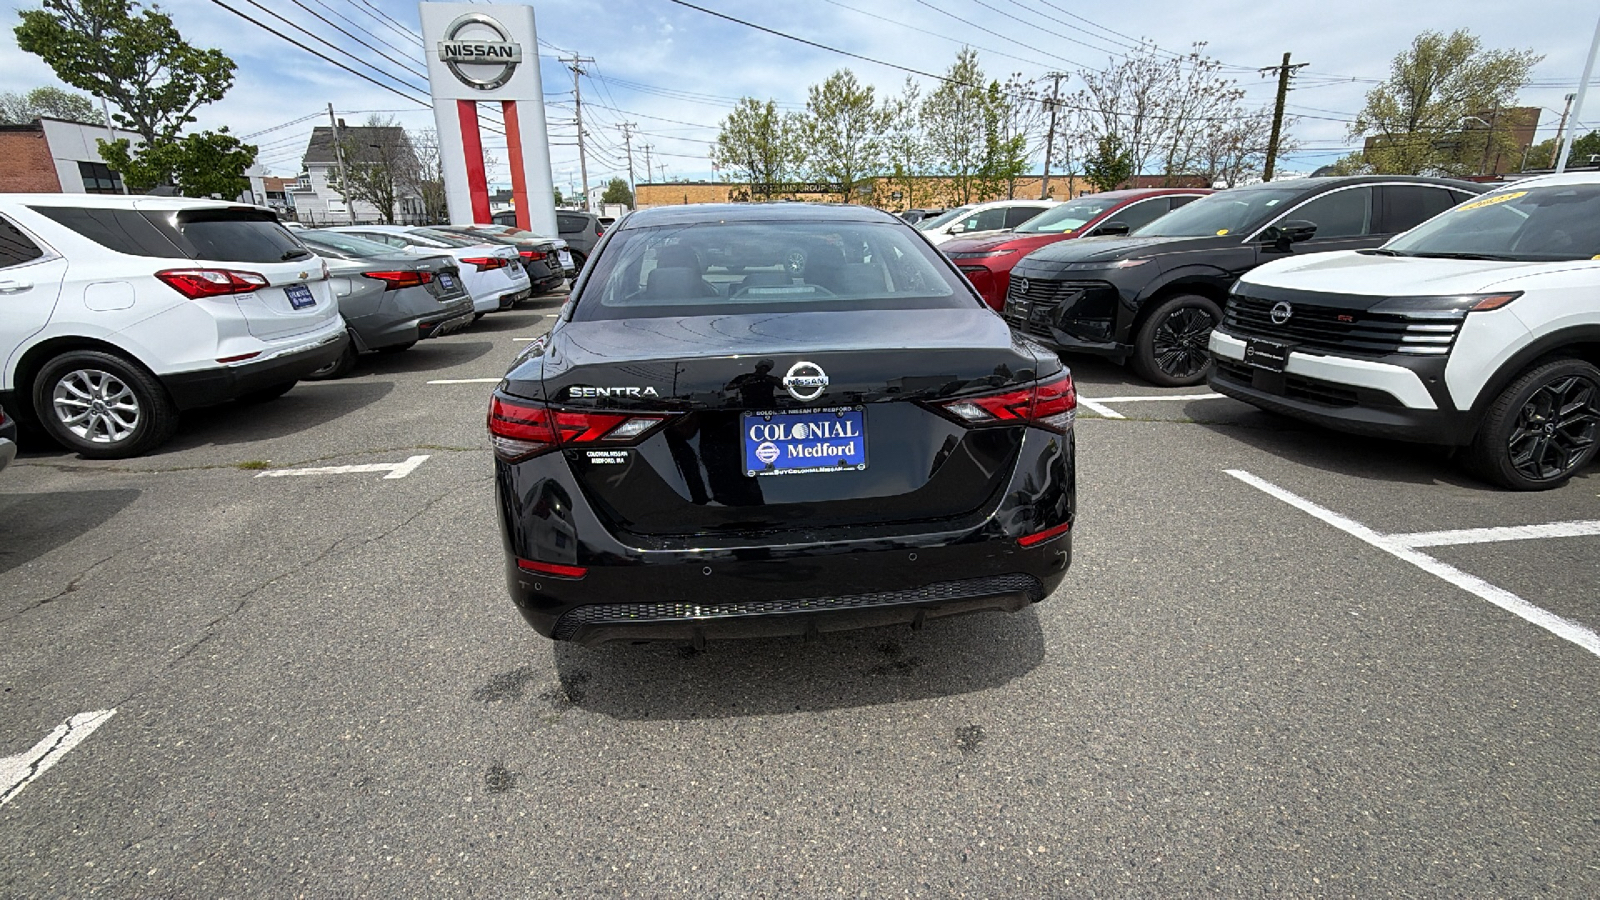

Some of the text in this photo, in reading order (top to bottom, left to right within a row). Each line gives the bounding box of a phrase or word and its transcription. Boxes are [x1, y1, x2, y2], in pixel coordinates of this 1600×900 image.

[444, 45, 513, 58] NISSAN
[788, 378, 824, 386] NISSAN
[569, 386, 659, 398] SENTRA
[749, 420, 859, 442] COLONIAL
[787, 441, 855, 459] Medford
